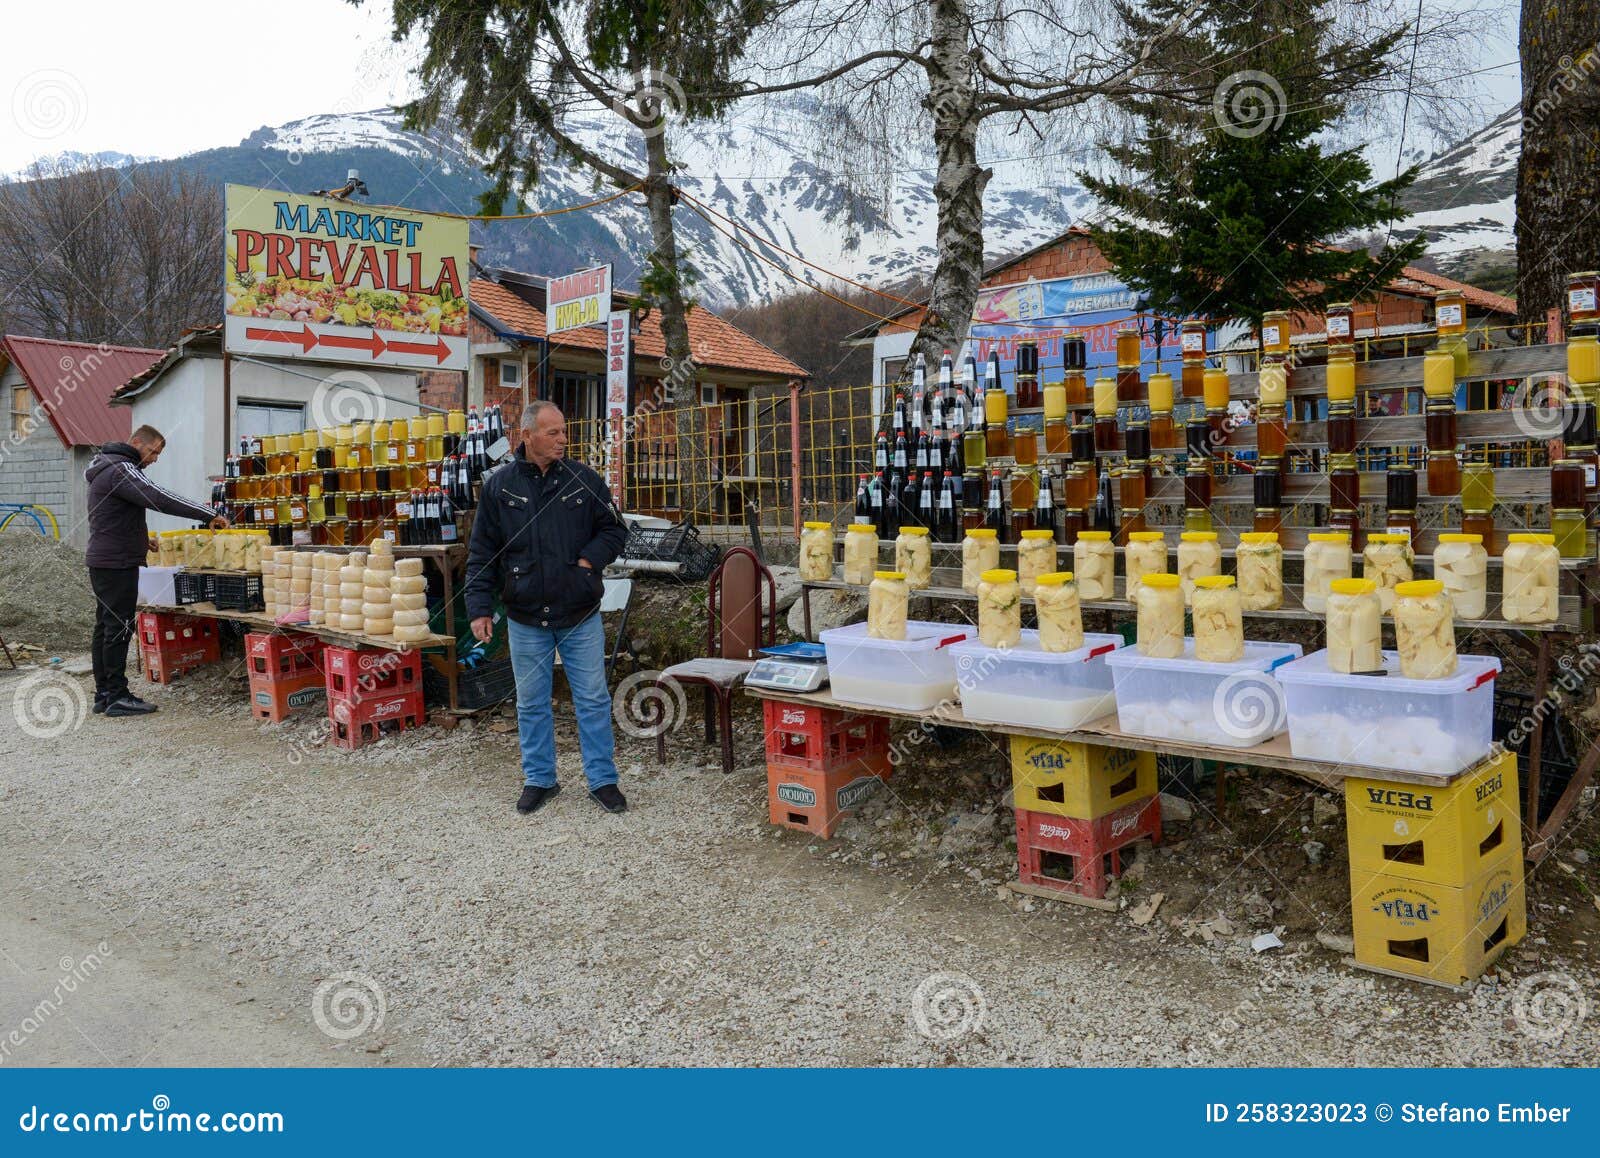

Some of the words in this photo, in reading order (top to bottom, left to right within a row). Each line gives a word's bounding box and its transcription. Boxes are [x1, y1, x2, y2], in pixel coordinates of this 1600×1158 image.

[274, 202, 423, 247] MARKET
[232, 229, 464, 299] PREVALLA
[551, 268, 607, 305] MARKET
[556, 297, 598, 329] HYRJA
[1064, 292, 1137, 312] PREVALLA
[1030, 752, 1065, 769] PEJA
[1366, 787, 1434, 811] PEJA
[1475, 773, 1503, 803] PEJA
[1381, 898, 1430, 921] PEJA
